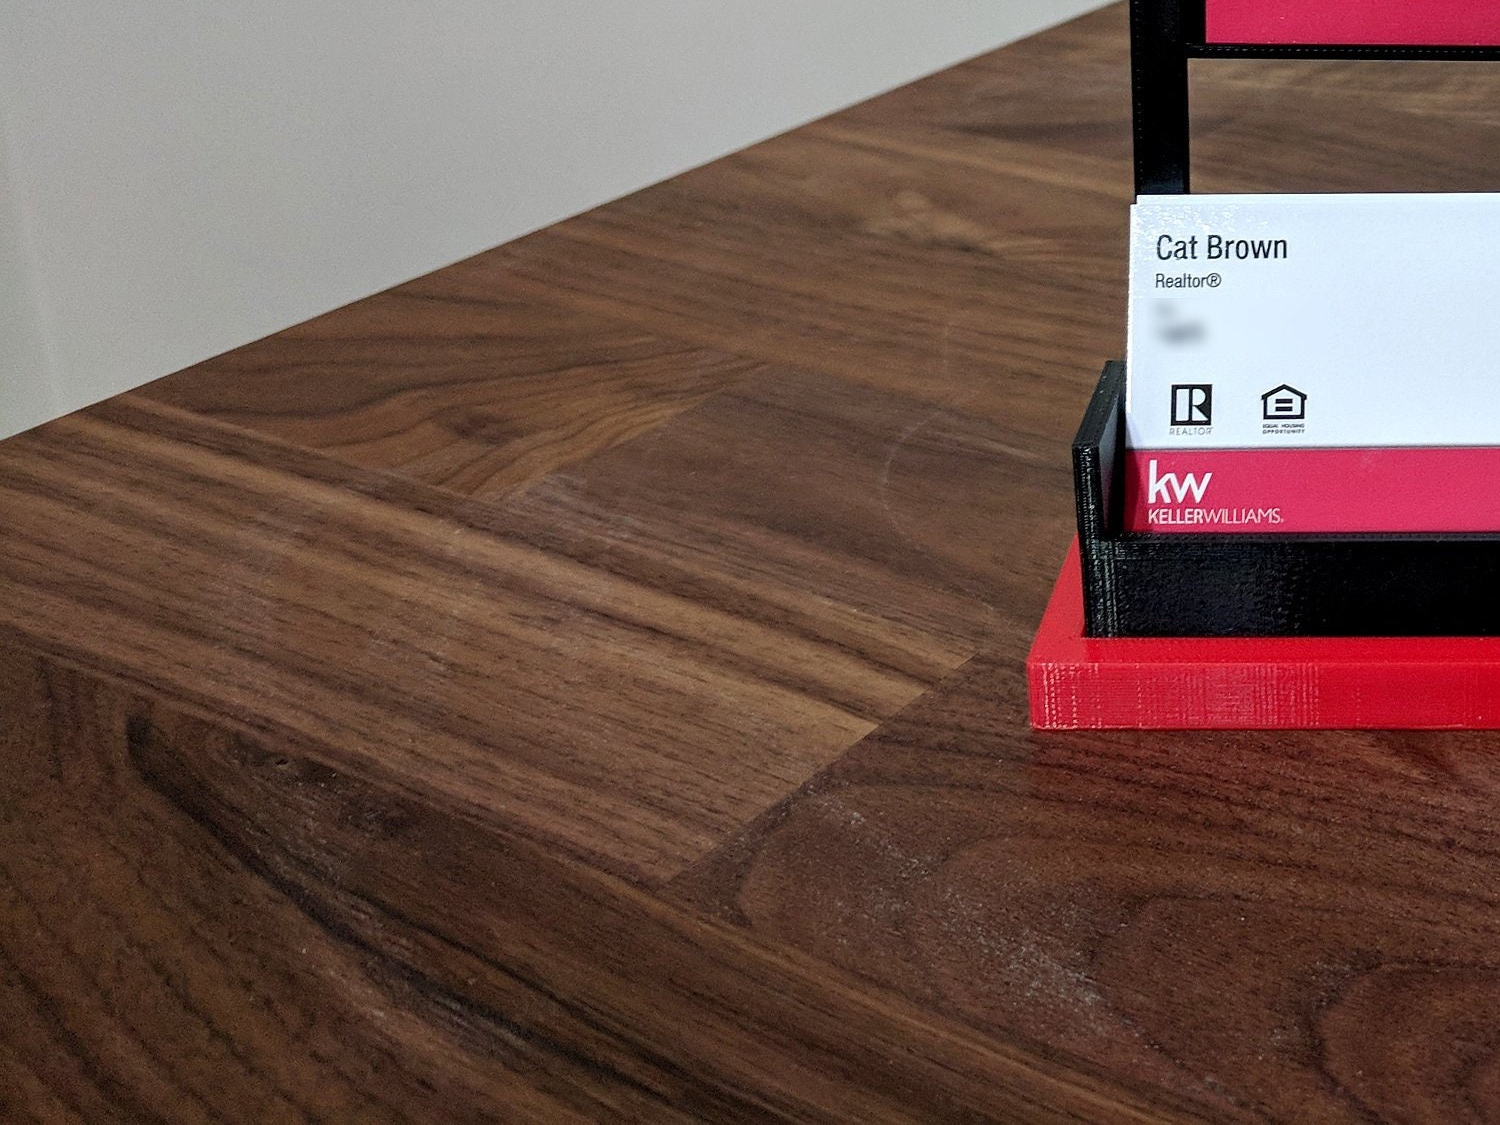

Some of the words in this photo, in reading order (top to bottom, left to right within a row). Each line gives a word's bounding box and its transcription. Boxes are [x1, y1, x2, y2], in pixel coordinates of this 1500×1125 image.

[1156, 234, 1198, 261] Cat
[1206, 234, 1288, 260] Brown
[1147, 459, 1213, 504] kw
